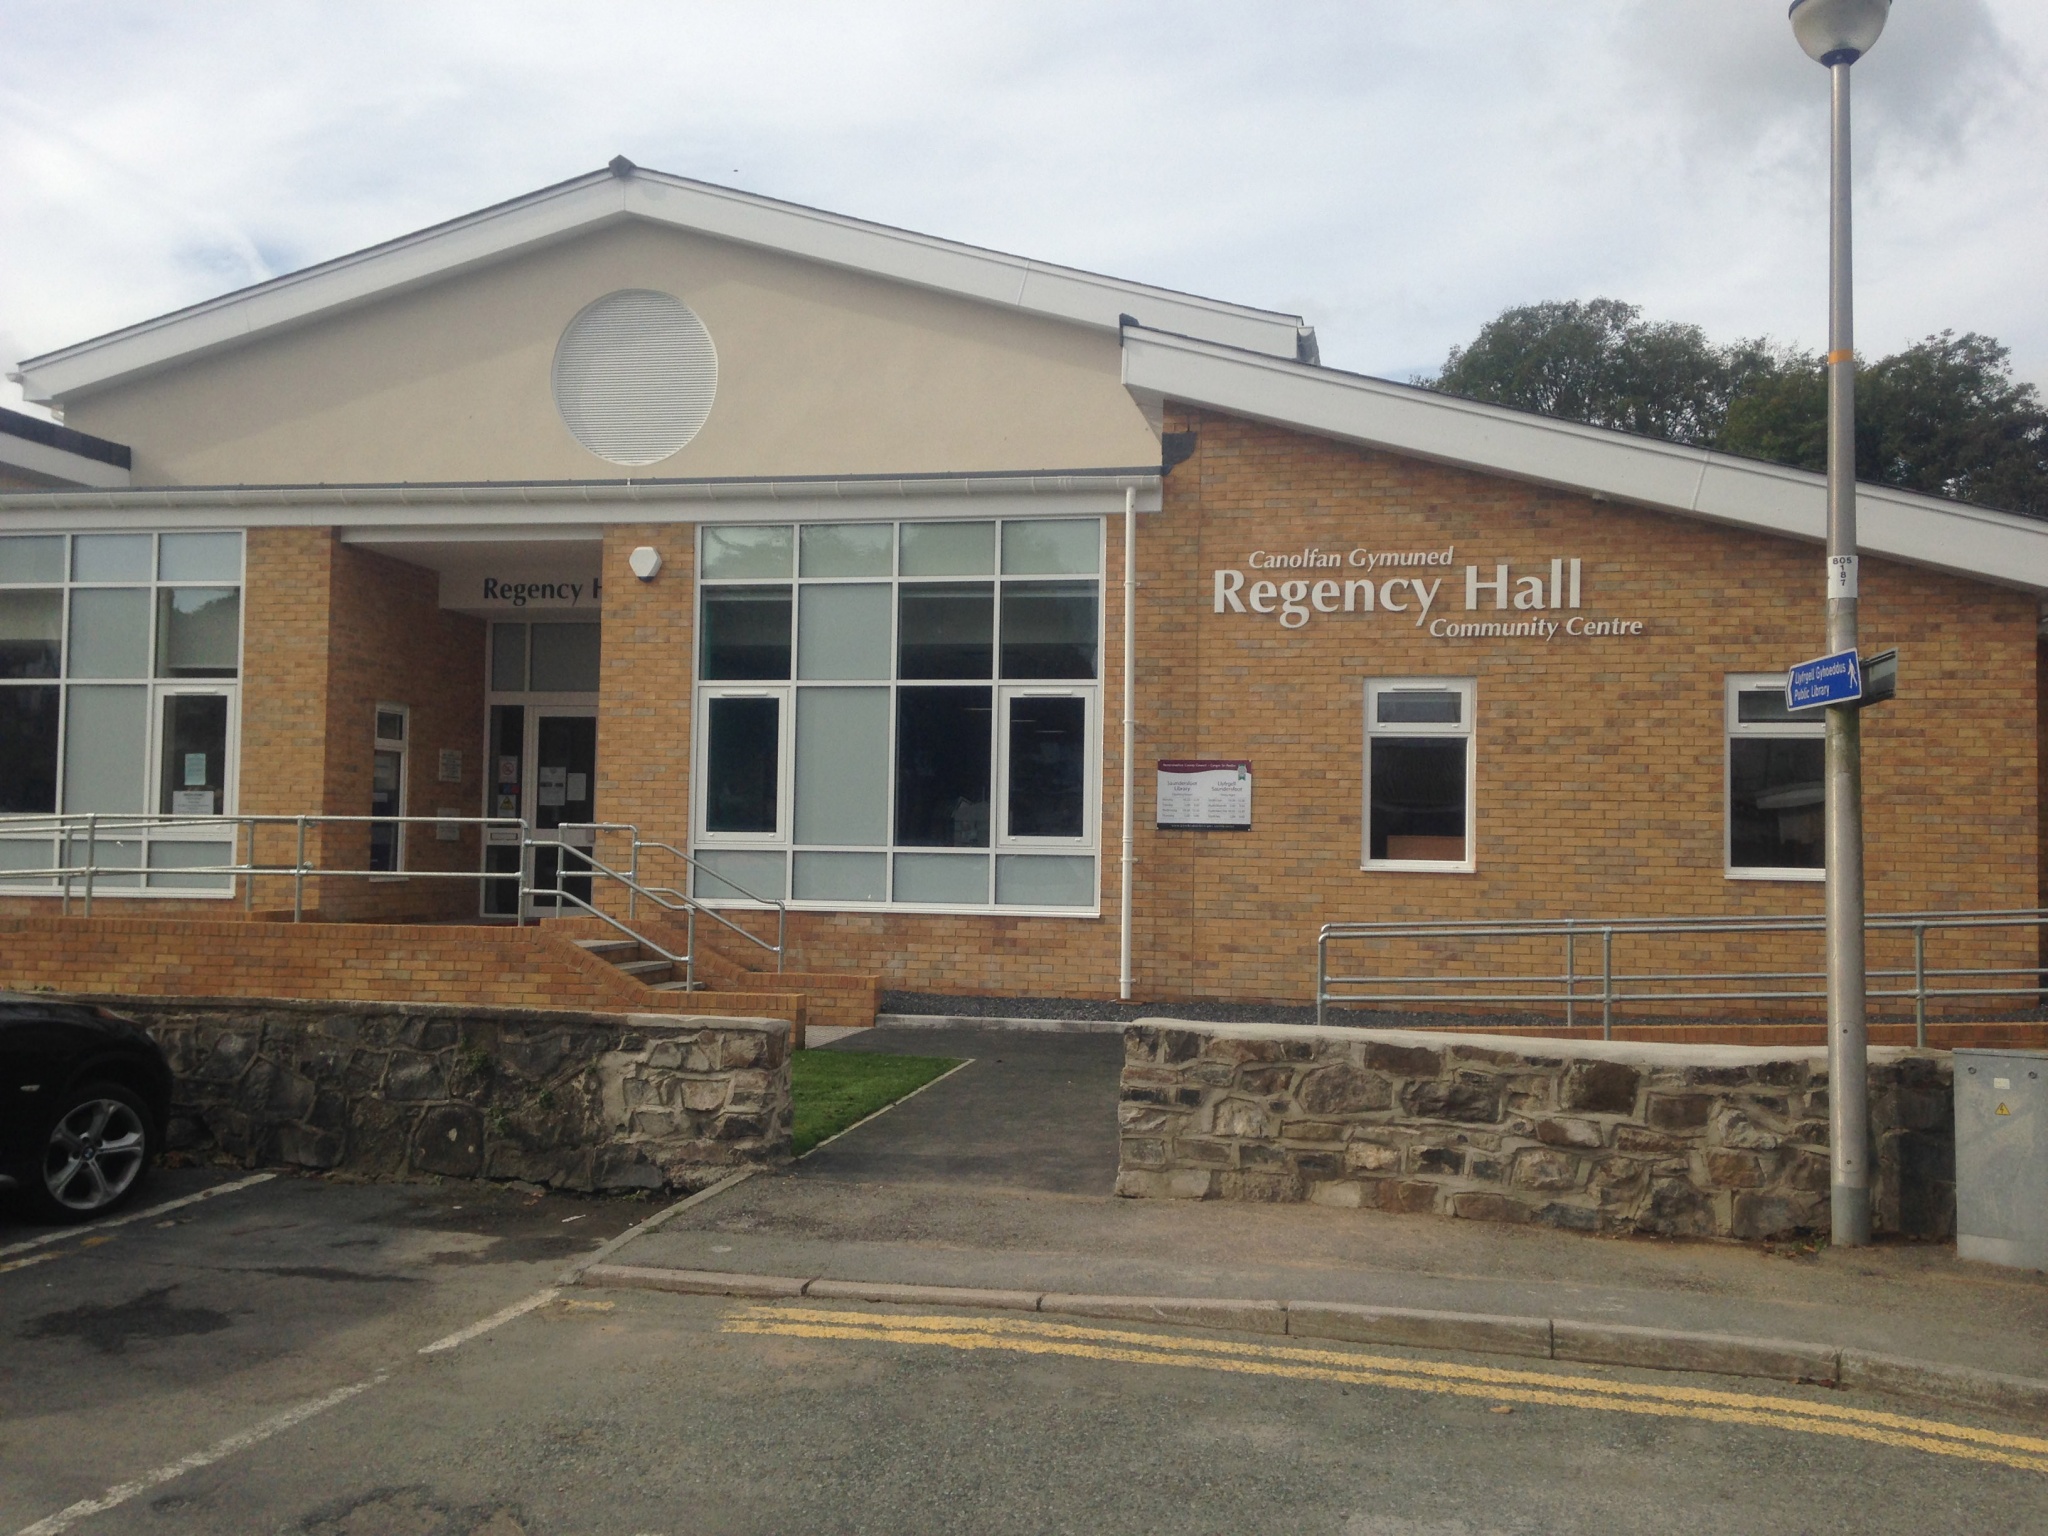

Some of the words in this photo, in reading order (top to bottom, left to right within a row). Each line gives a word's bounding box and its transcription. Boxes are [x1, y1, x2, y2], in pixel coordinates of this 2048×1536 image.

[1248, 548, 1341, 569] Canolfan
[1348, 545, 1454, 572] Gymuned
[484, 577, 583, 607] Regency
[1213, 569, 1441, 628] Regency
[1465, 558, 1581, 610] Hall
[1429, 617, 1558, 642] Community
[1565, 616, 1643, 635] Centre
[1794, 687, 1809, 701] Public
[1811, 685, 1830, 697] Library
